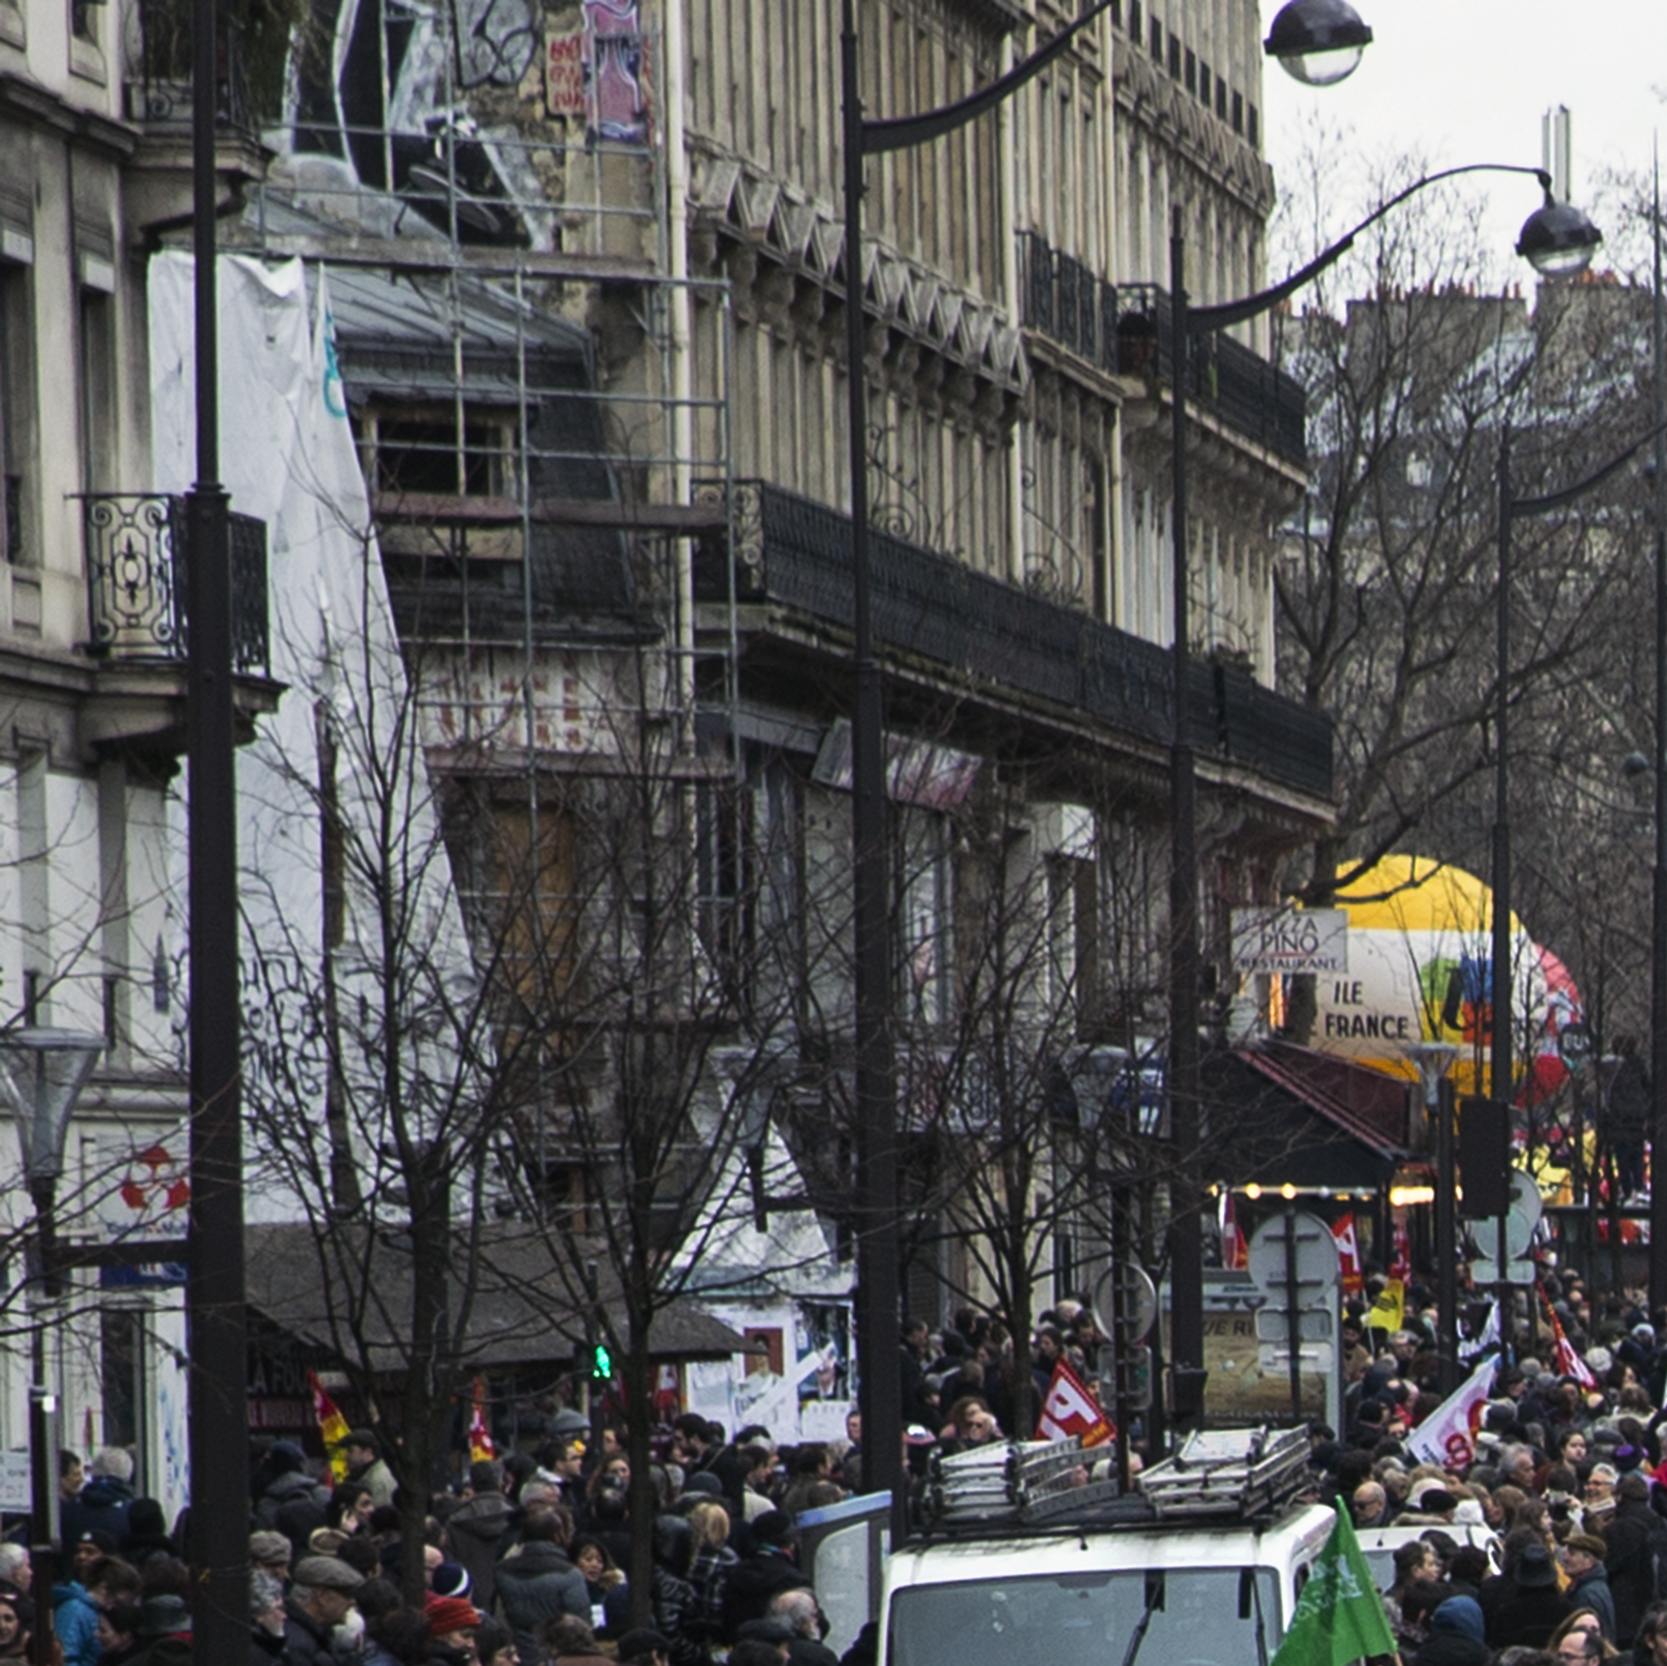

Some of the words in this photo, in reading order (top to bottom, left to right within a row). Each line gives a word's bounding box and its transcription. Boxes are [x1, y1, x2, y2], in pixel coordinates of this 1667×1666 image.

[1260, 933, 1320, 953] PINO
[1333, 980, 1365, 1005] ILE
[1325, 1012, 1410, 1039] FRANCE
